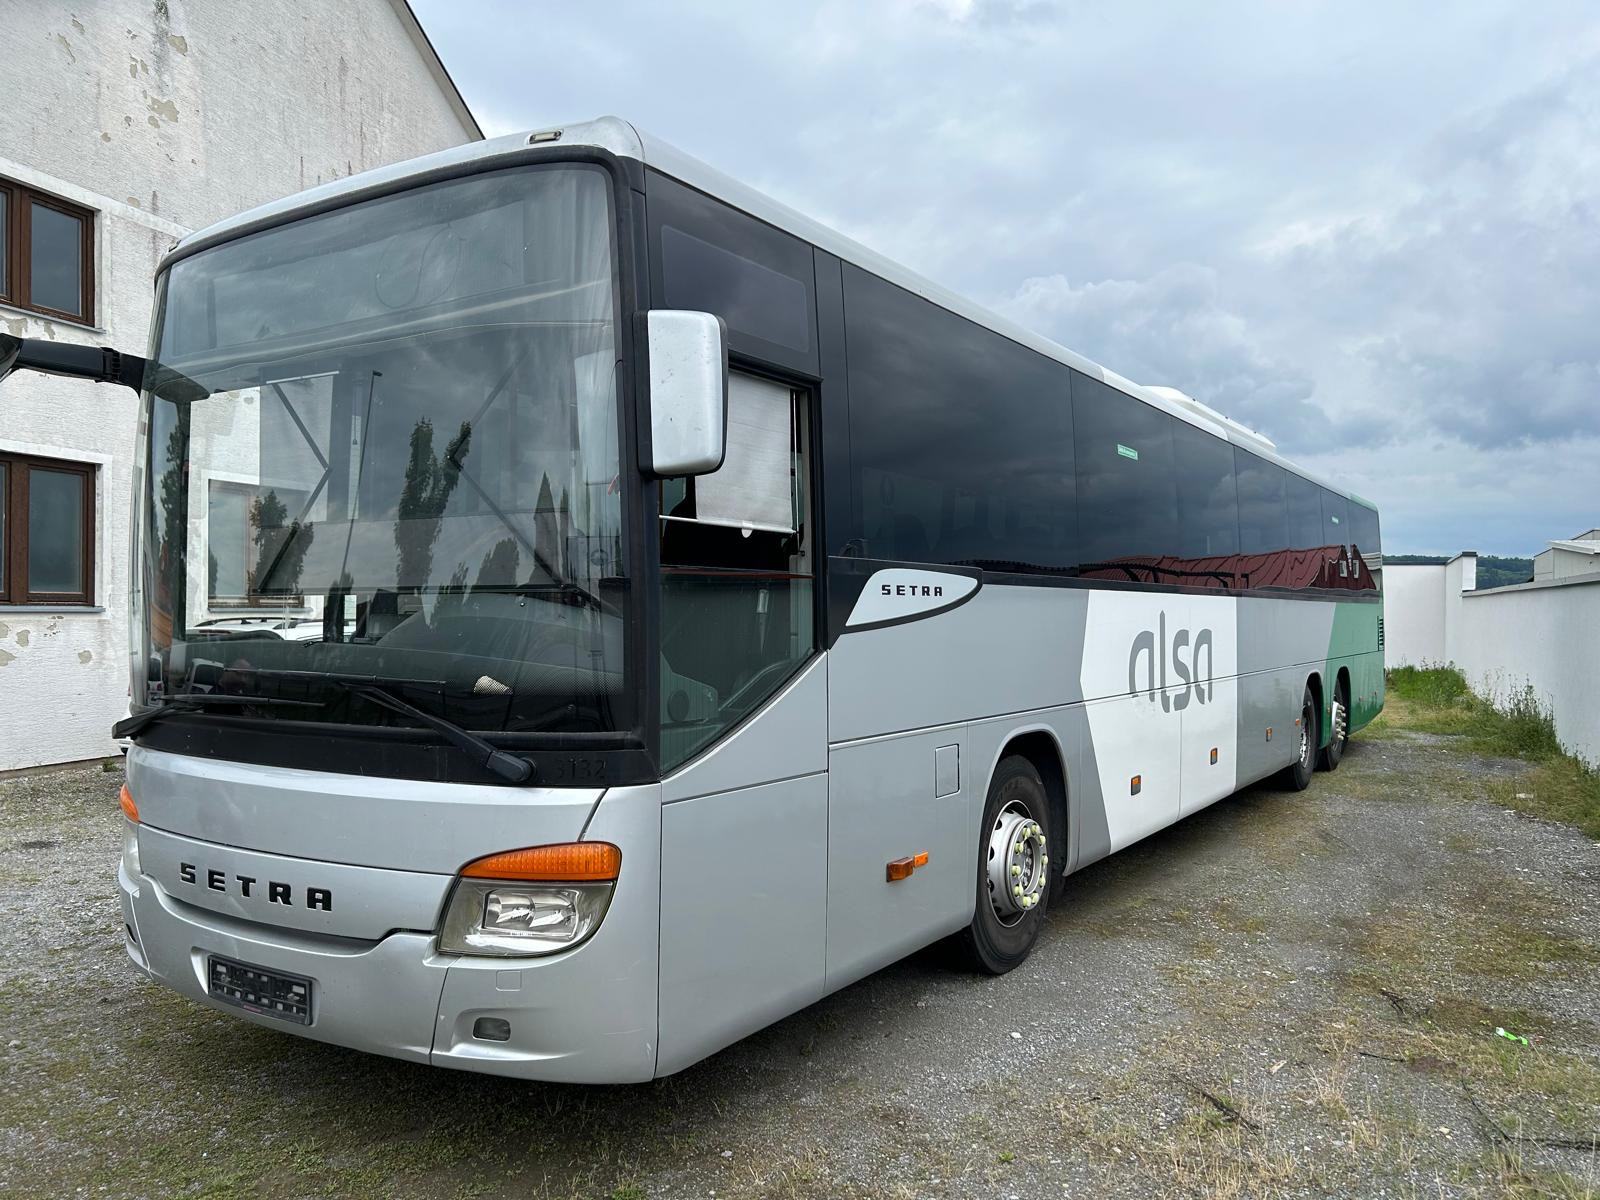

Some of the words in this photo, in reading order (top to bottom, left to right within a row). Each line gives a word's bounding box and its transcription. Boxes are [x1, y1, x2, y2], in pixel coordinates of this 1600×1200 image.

[881, 585, 942, 597] SETRA
[1129, 610, 1212, 713] alsa
[180, 862, 332, 911] SETRA
